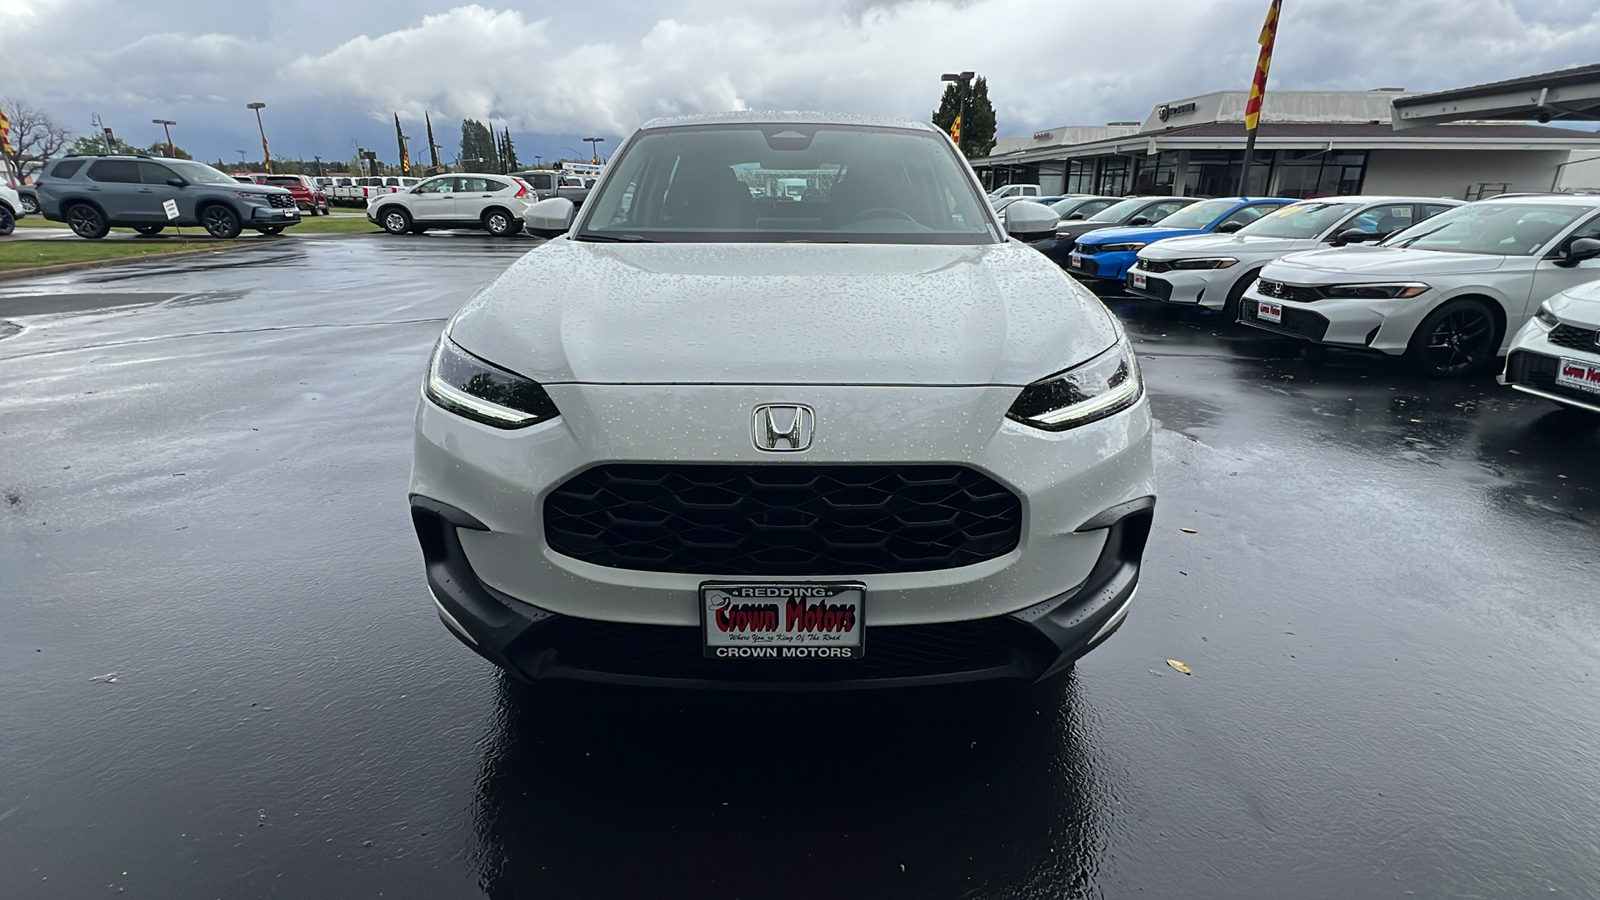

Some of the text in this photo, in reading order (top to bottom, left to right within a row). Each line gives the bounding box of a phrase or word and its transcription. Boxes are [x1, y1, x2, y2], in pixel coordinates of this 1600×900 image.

[741, 588, 826, 597] REDDING
[715, 597, 856, 632] Crown Motors
[729, 633, 841, 643] Where You're King Of The Road
[716, 647, 852, 658] CROWN MOTORS
